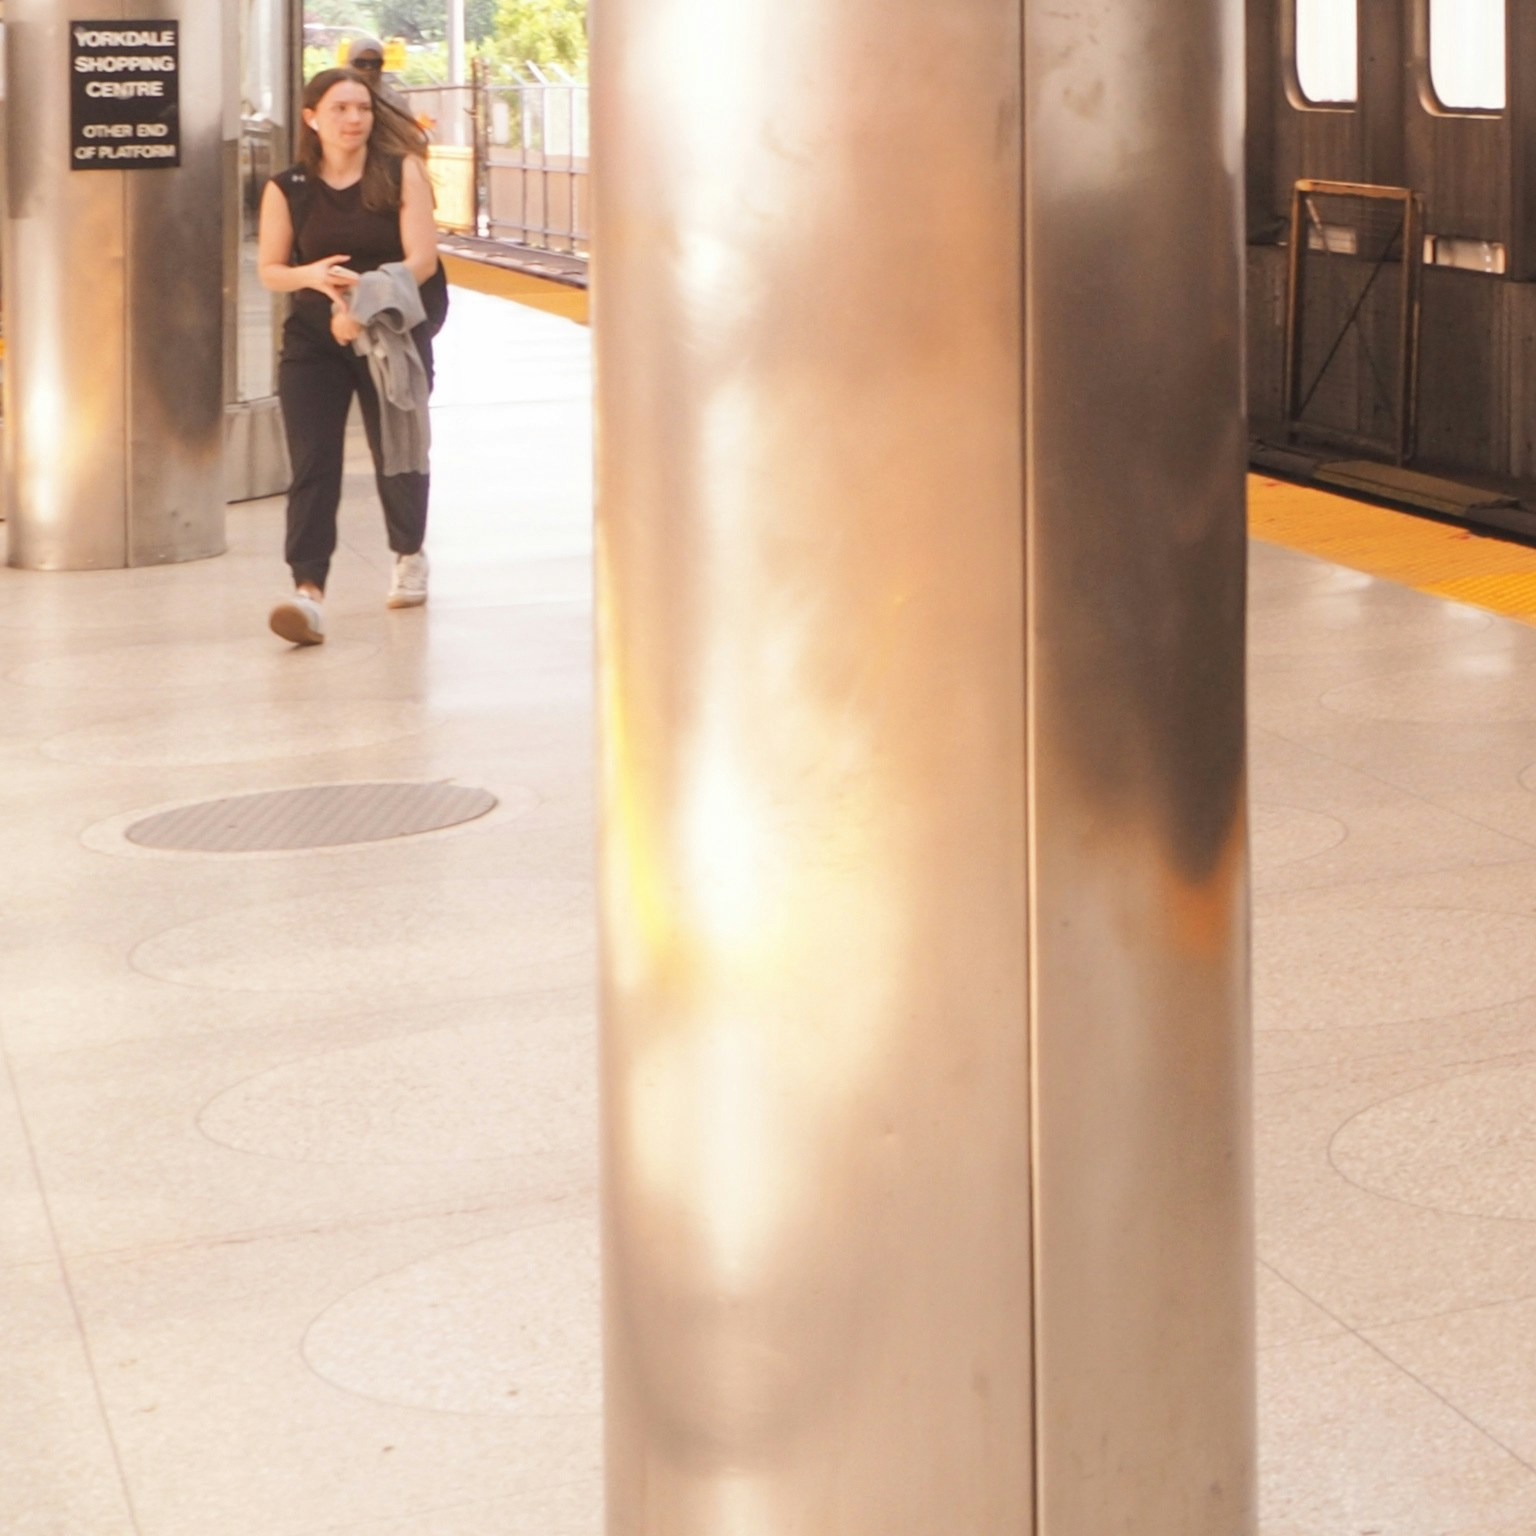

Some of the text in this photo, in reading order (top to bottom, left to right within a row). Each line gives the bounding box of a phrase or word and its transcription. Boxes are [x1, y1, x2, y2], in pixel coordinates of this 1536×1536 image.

[74, 30, 176, 48] YORKDALE
[74, 55, 176, 73] SHOPPING
[85, 80, 164, 98] CENTRE
[82, 123, 168, 138] OTHER END
[74, 144, 176, 160] OF PLATFORM
